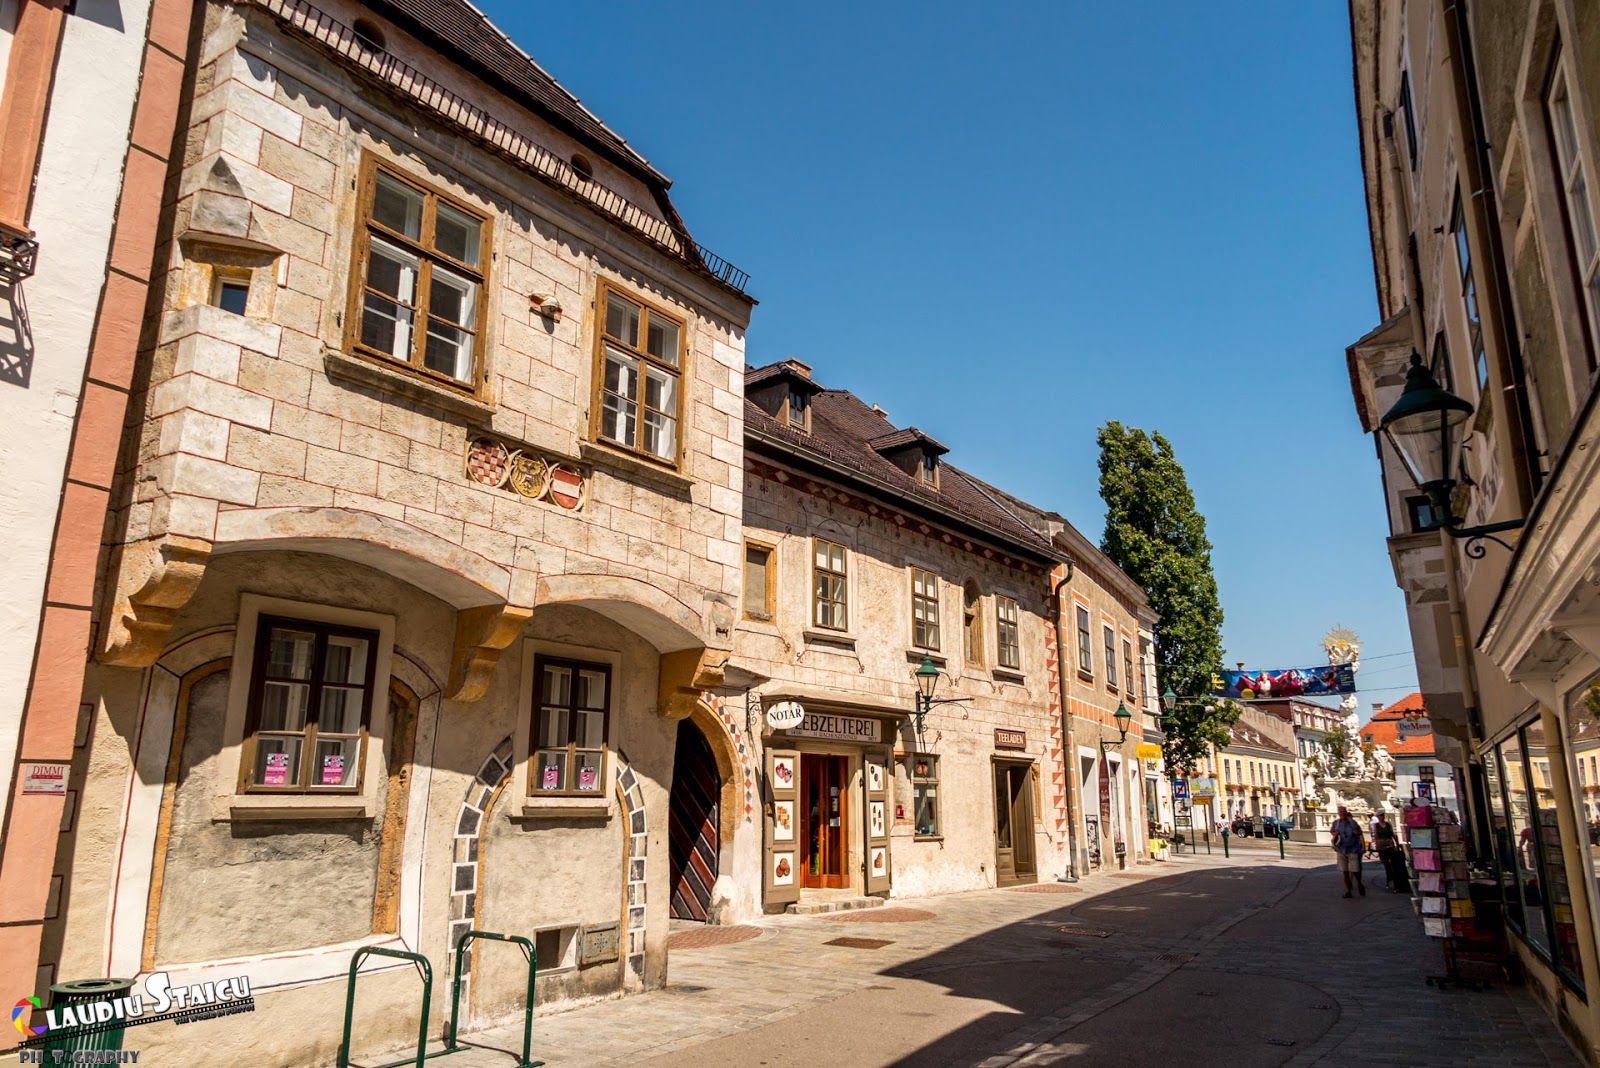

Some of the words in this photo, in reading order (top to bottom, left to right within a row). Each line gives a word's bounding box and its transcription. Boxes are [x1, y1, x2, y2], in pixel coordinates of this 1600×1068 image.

[769, 708, 802, 722] NOTAR
[998, 732, 1024, 744] TEELADEN
[33, 766, 64, 775] DIMMI
